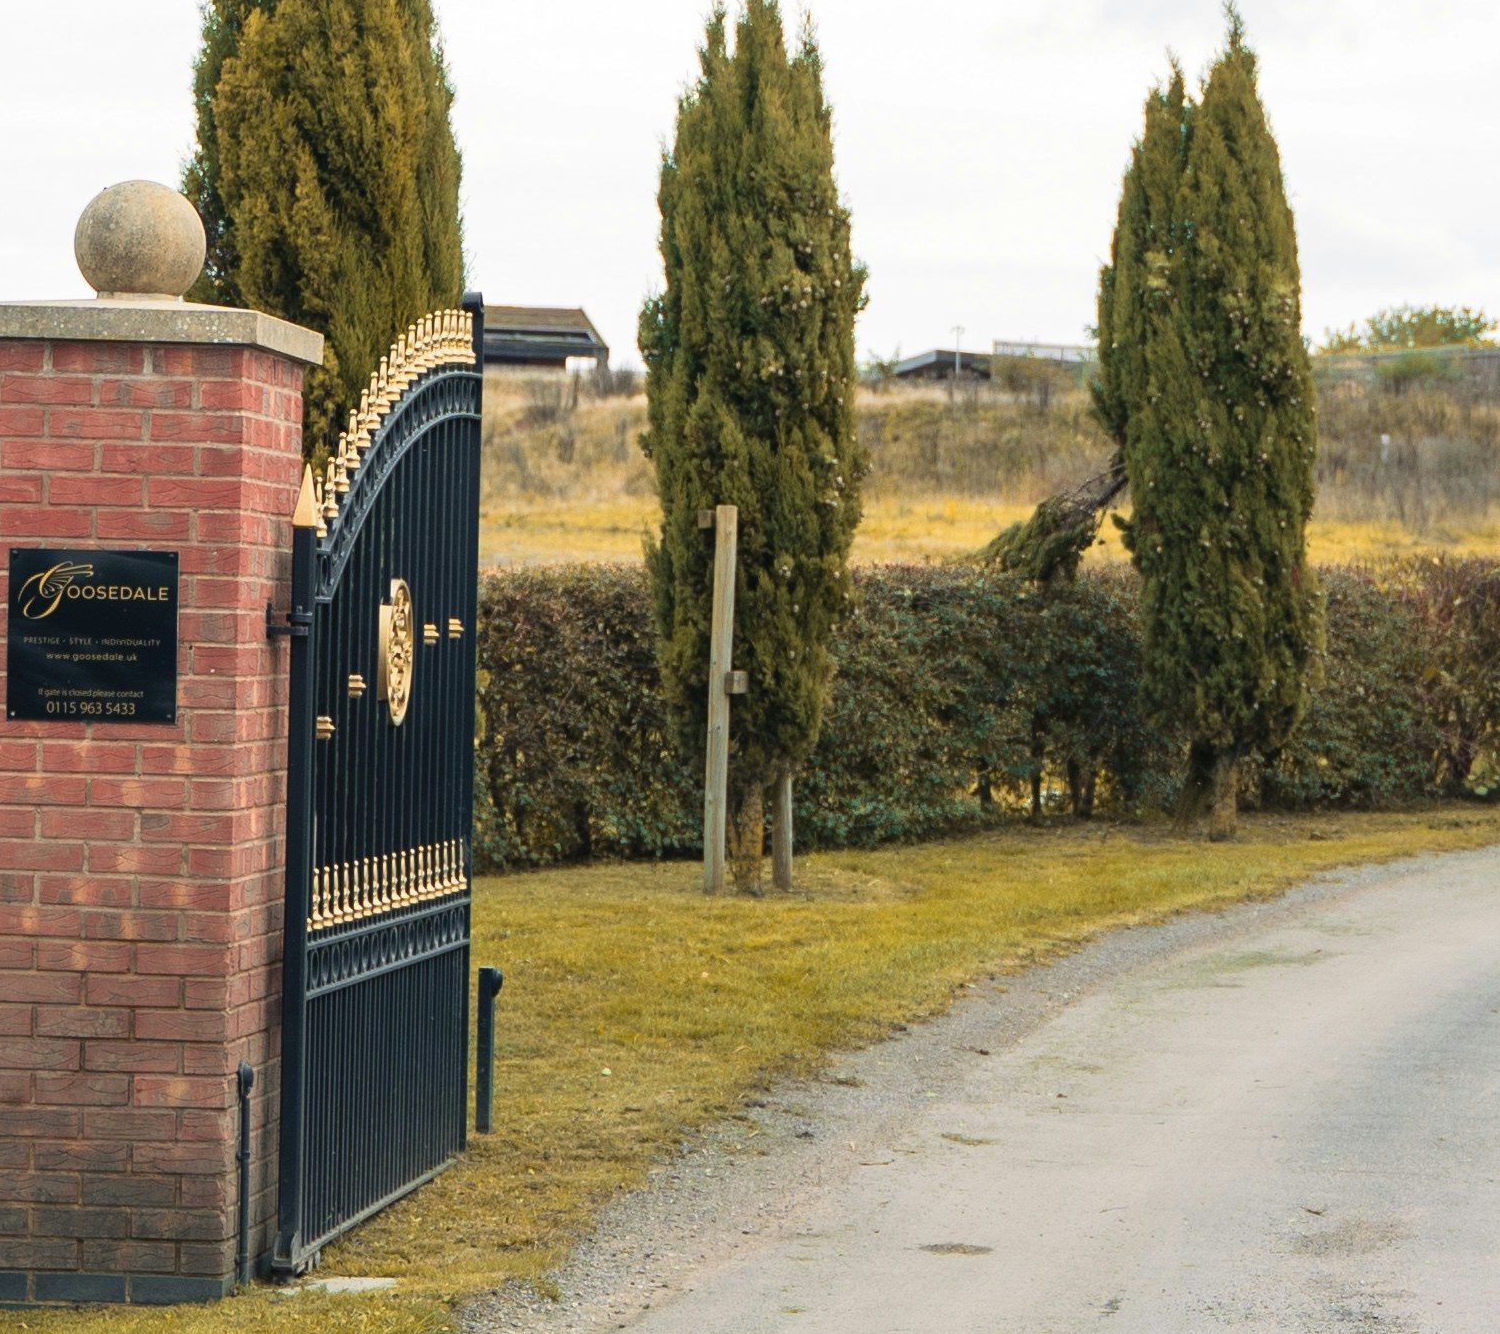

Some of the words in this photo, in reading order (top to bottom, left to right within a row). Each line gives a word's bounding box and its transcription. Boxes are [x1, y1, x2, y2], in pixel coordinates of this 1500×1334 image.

[17, 560, 170, 620] GOOSEDALE
[23, 636, 60, 645] PRESTIGE
[69, 636, 92, 646] STYLE
[101, 637, 161, 647] INDIVIDUALITY
[44, 688, 60, 697] gate
[61, 688, 68, 696] is
[68, 688, 92, 697] closed
[92, 689, 115, 698] please
[116, 690, 144, 698] contact
[46, 700, 77, 714] 0115
[80, 701, 103, 715] 963
[105, 702, 136, 716] 5433
